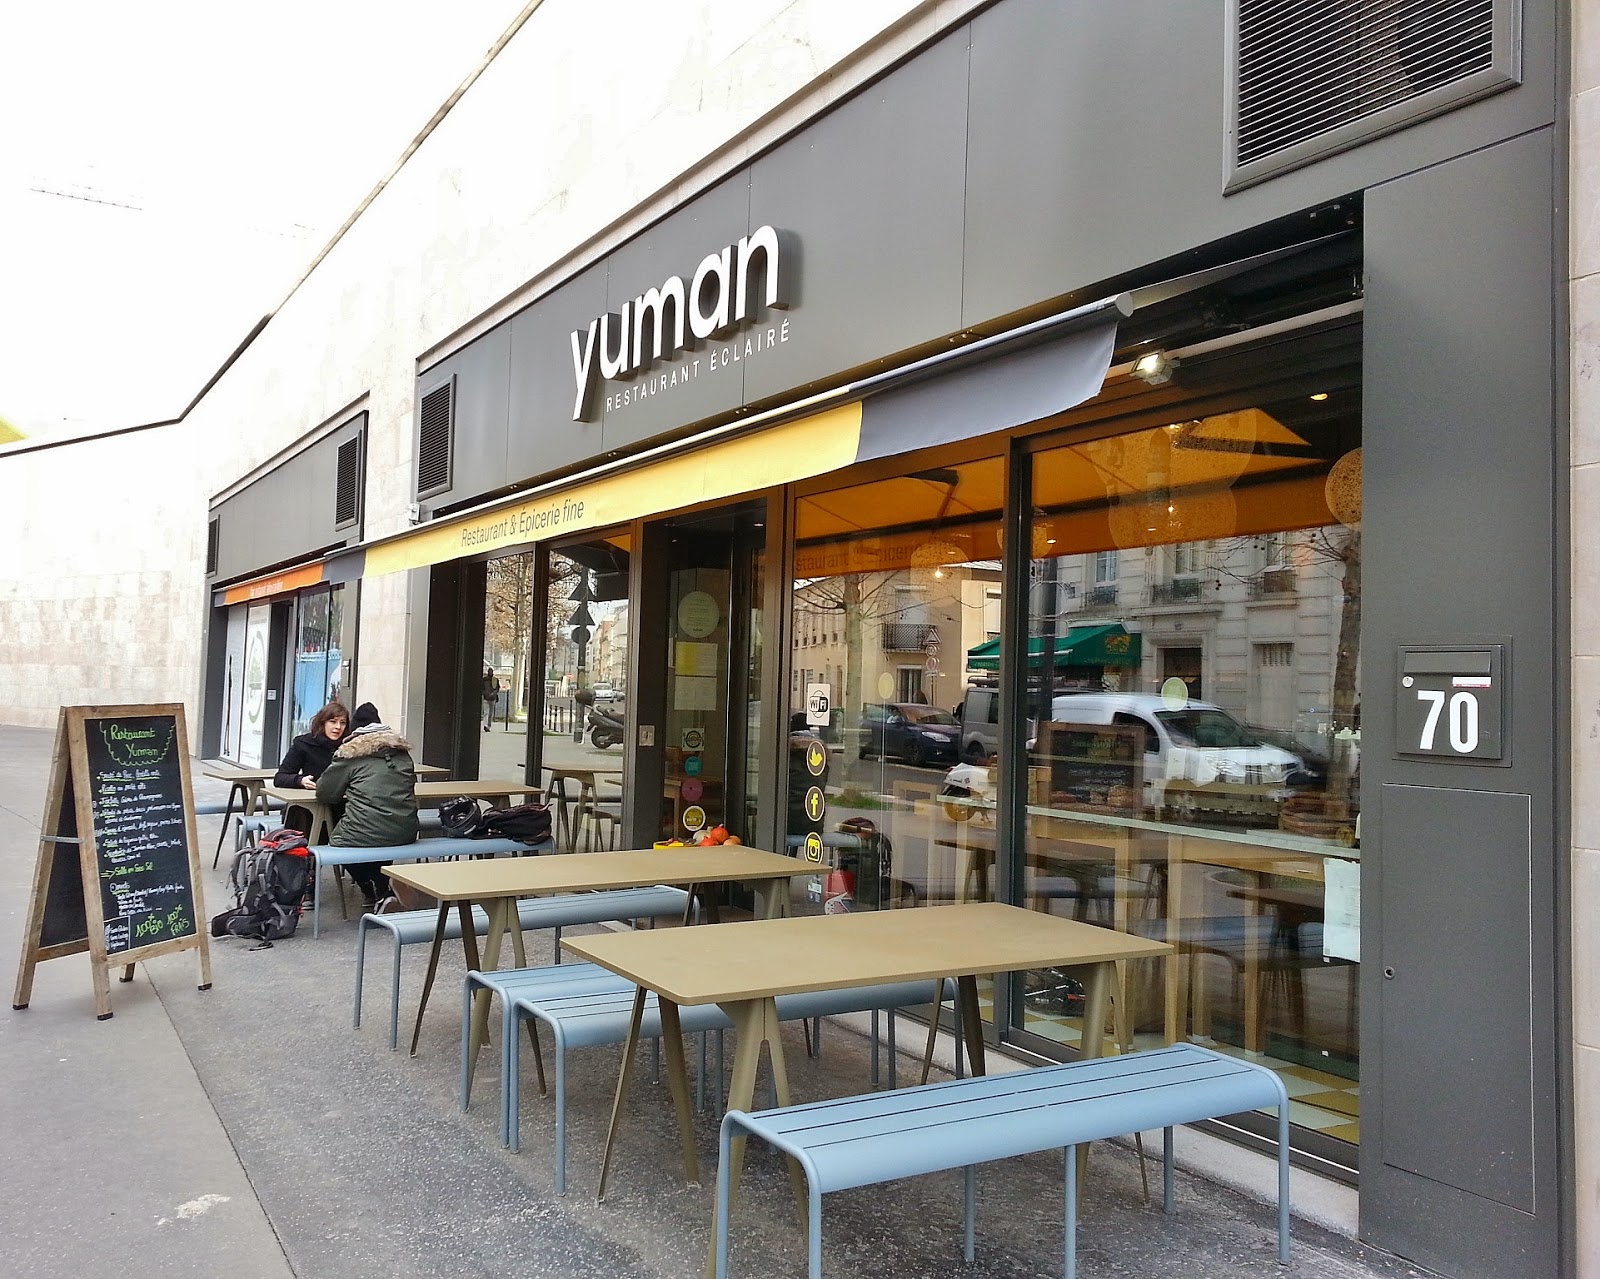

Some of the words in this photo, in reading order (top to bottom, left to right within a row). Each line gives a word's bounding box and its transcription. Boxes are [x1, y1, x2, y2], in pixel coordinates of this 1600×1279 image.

[571, 225, 779, 421] yuman
[606, 360, 700, 413] RESTAURANT
[710, 318, 791, 371] ÉCLAIRÉ
[461, 518, 508, 547] Restaurant
[510, 514, 517, 535] &
[519, 504, 560, 538] Épicerie
[562, 498, 584, 523] fine
[796, 550, 849, 572] staurant
[110, 724, 155, 740] Restaurant
[1417, 690, 1479, 753] 70
